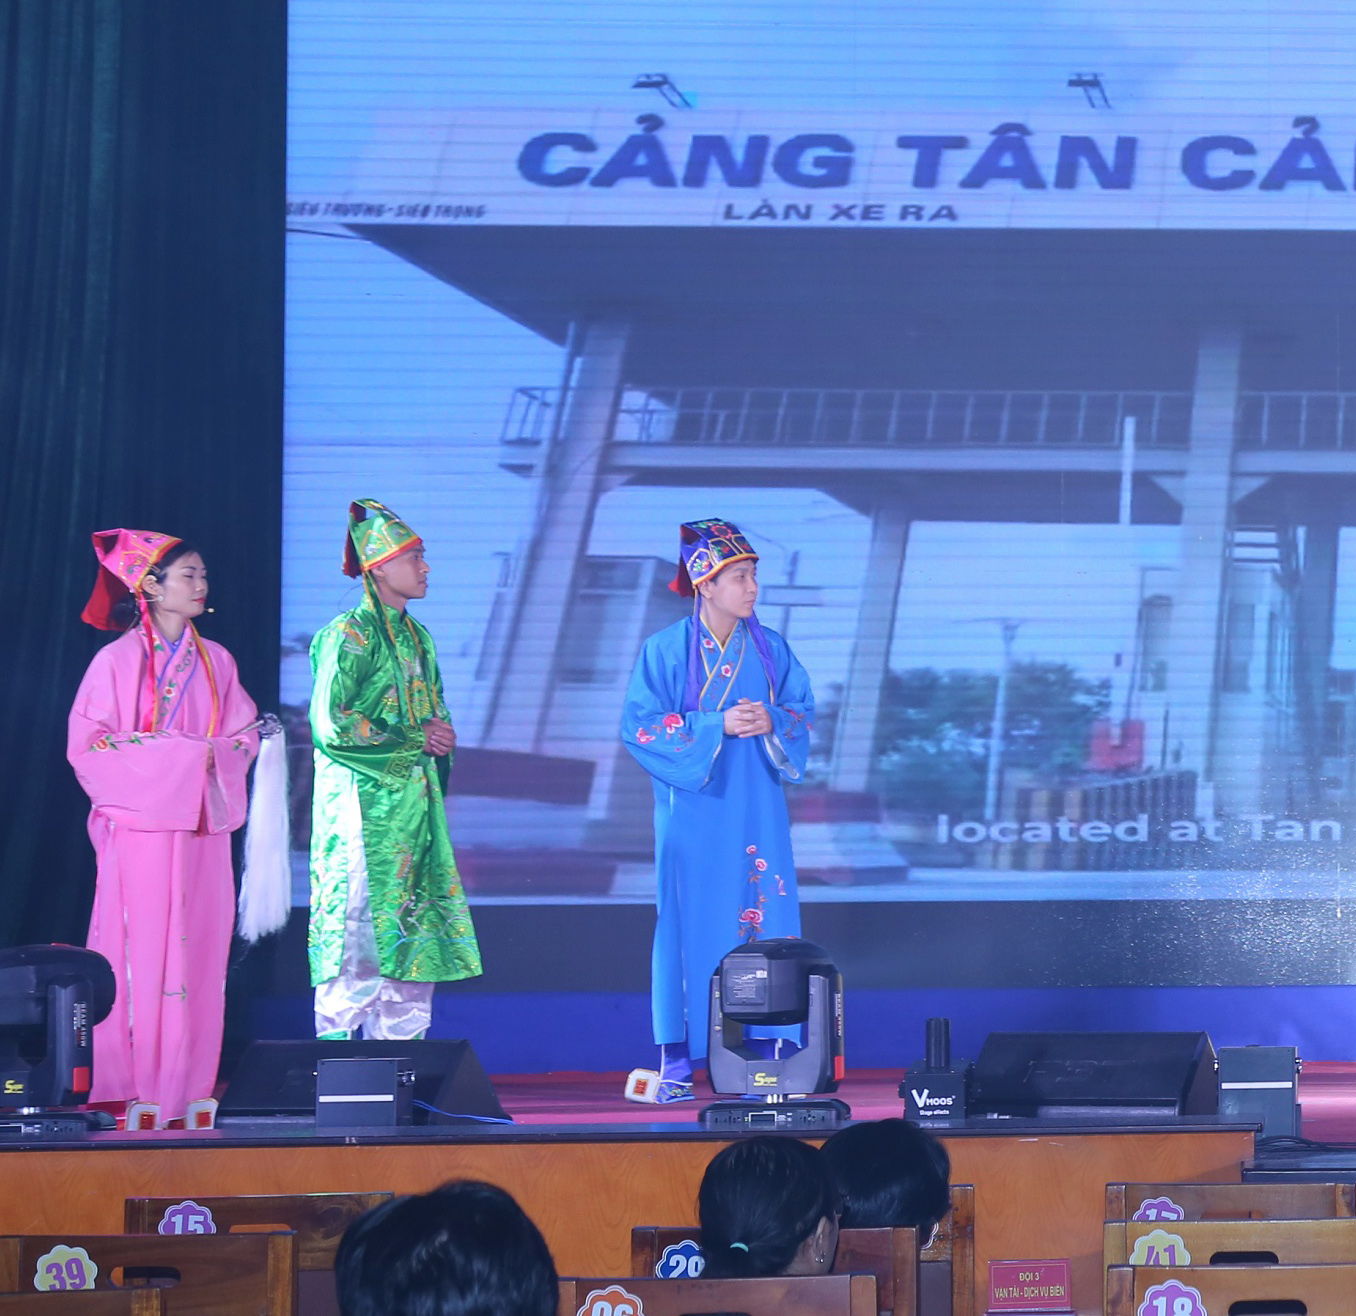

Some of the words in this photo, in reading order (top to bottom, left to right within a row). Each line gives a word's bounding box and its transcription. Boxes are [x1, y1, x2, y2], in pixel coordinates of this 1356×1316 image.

[517, 112, 856, 188] CẢNG
[896, 122, 1138, 190] TÂN
[723, 199, 813, 220] LÀN
[829, 204, 886, 220] XE
[899, 204, 958, 221] RA
[936, 814, 1149, 843] located
[1168, 819, 1224, 842] at
[1242, 814, 1341, 842] Tan
[170, 1213, 206, 1235] 15
[45, 1257, 88, 1291] 39
[1034, 1272, 1040, 1281] 3
[1152, 1296, 1195, 1316] 18
